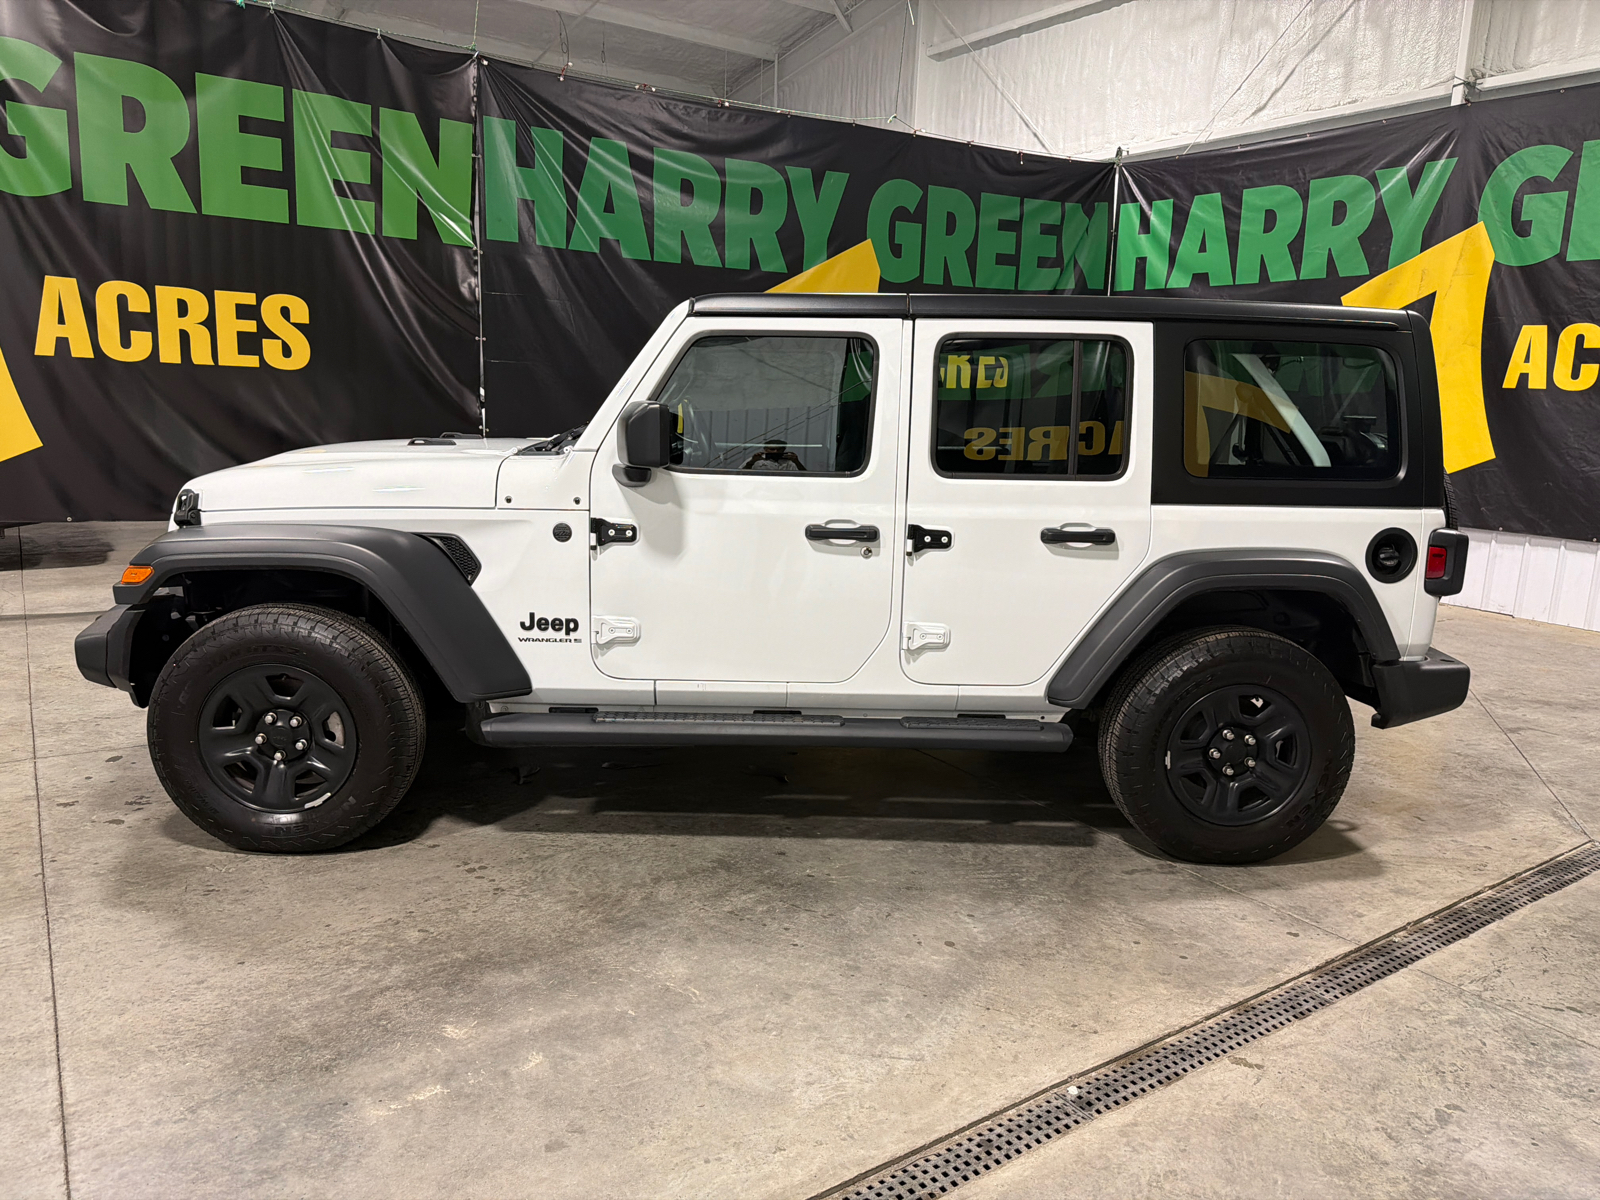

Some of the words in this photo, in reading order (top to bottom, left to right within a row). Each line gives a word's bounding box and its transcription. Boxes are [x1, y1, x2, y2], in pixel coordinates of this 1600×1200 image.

[0, 36, 476, 248] GREEN
[482, 115, 850, 274] HARRY
[866, 179, 1109, 292] GREEN
[1113, 157, 1459, 291] HARRY
[34, 275, 311, 371] ACRES
[519, 612, 580, 636] Jeep
